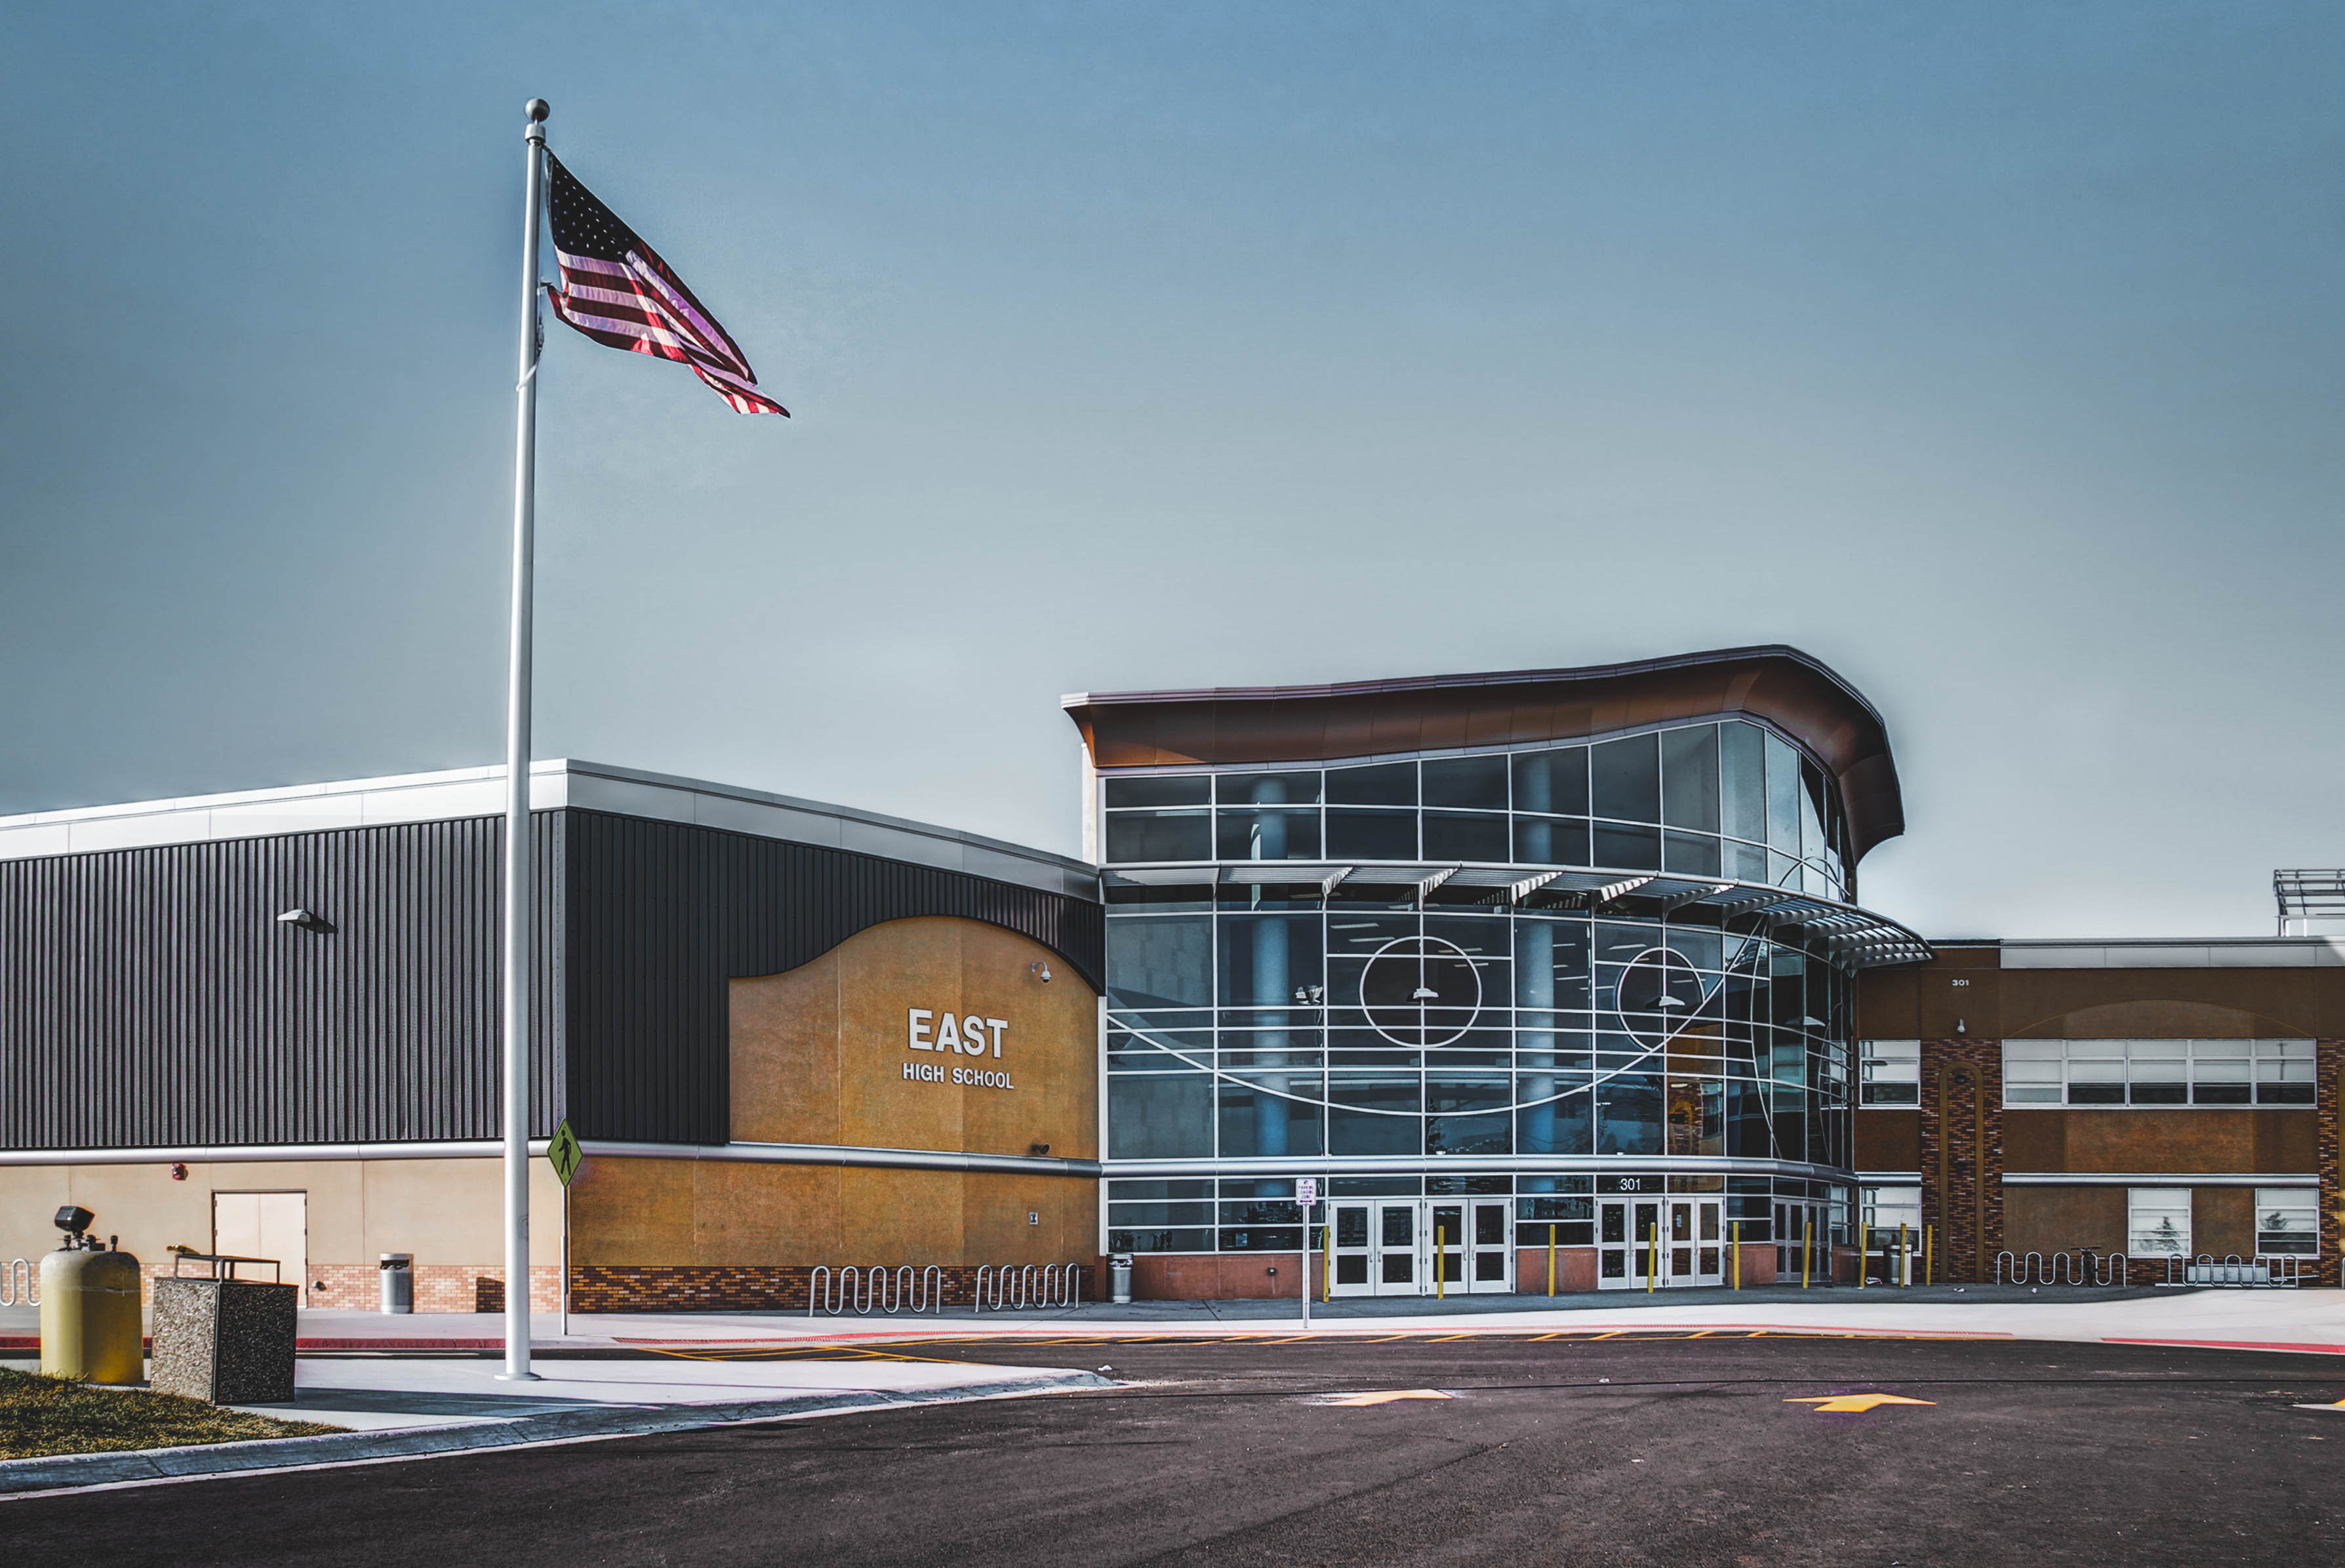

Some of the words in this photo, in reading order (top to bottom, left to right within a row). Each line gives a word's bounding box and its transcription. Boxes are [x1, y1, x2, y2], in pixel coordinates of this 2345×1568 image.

[908, 1008, 1009, 1058] EAST
[902, 1062, 944, 1083] HIGH
[952, 1067, 1014, 1089] SCHOOL
[1620, 1178, 1641, 1191] 301
